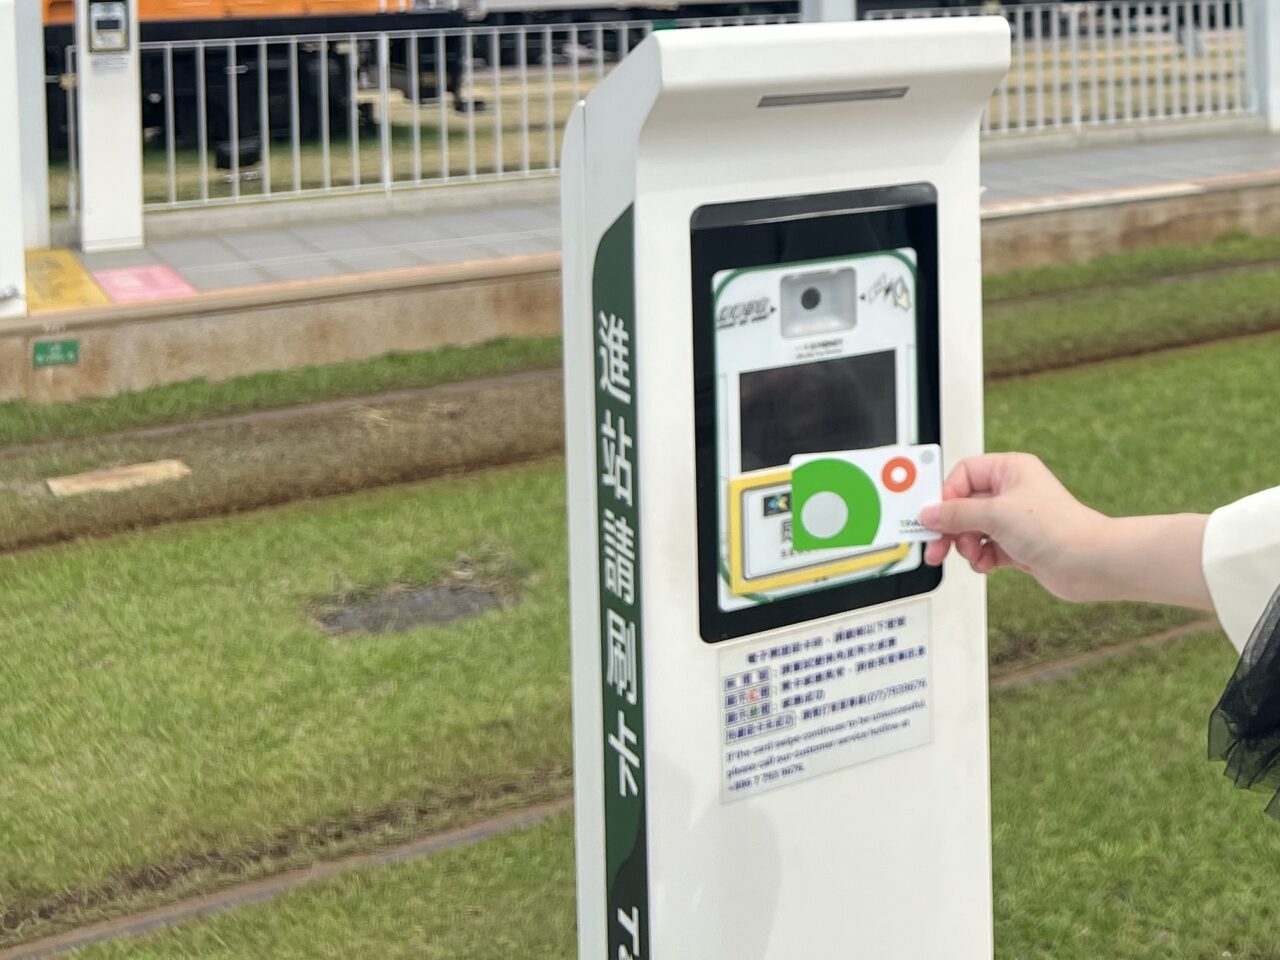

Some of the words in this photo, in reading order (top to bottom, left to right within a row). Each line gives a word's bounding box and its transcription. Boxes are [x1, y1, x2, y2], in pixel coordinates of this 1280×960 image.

[599, 309, 641, 797] 進站請刷卡
